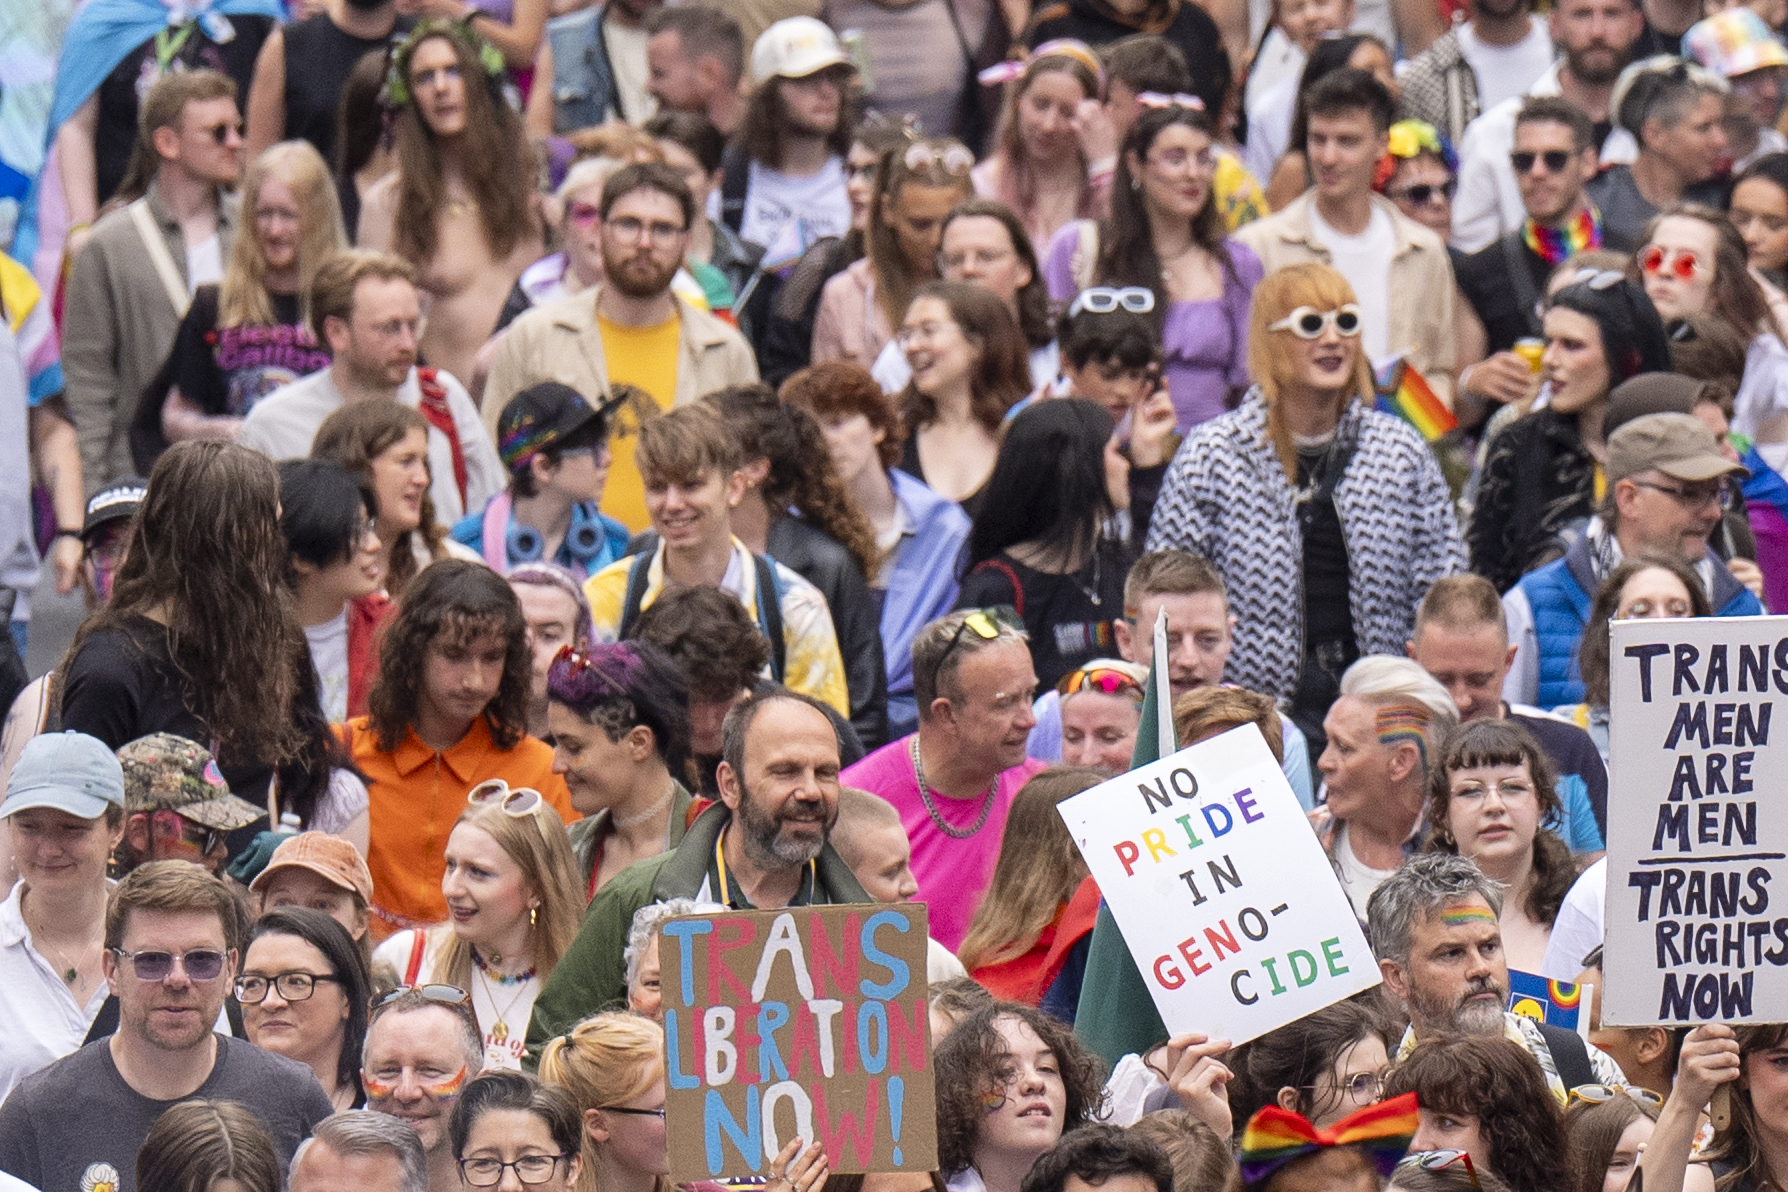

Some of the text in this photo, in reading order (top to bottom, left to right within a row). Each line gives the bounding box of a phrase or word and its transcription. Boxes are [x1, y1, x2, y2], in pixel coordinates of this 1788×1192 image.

[1664, 701, 1772, 750] MEN
[1137, 767, 1199, 814] NO
[1668, 752, 1755, 801] ARE
[1113, 787, 1265, 877] PRIDE
[1652, 802, 1757, 852] MEN
[1180, 855, 1243, 907] IN
[1628, 867, 1772, 921] TRANS
[663, 910, 911, 1007] TRANS
[1153, 903, 1288, 990] GENO-
[1230, 937, 1349, 1005] CIDE
[1659, 971, 1753, 1020] NOW
[666, 998, 927, 1090] LIBERATION
[704, 1075, 905, 1176] NOW!
